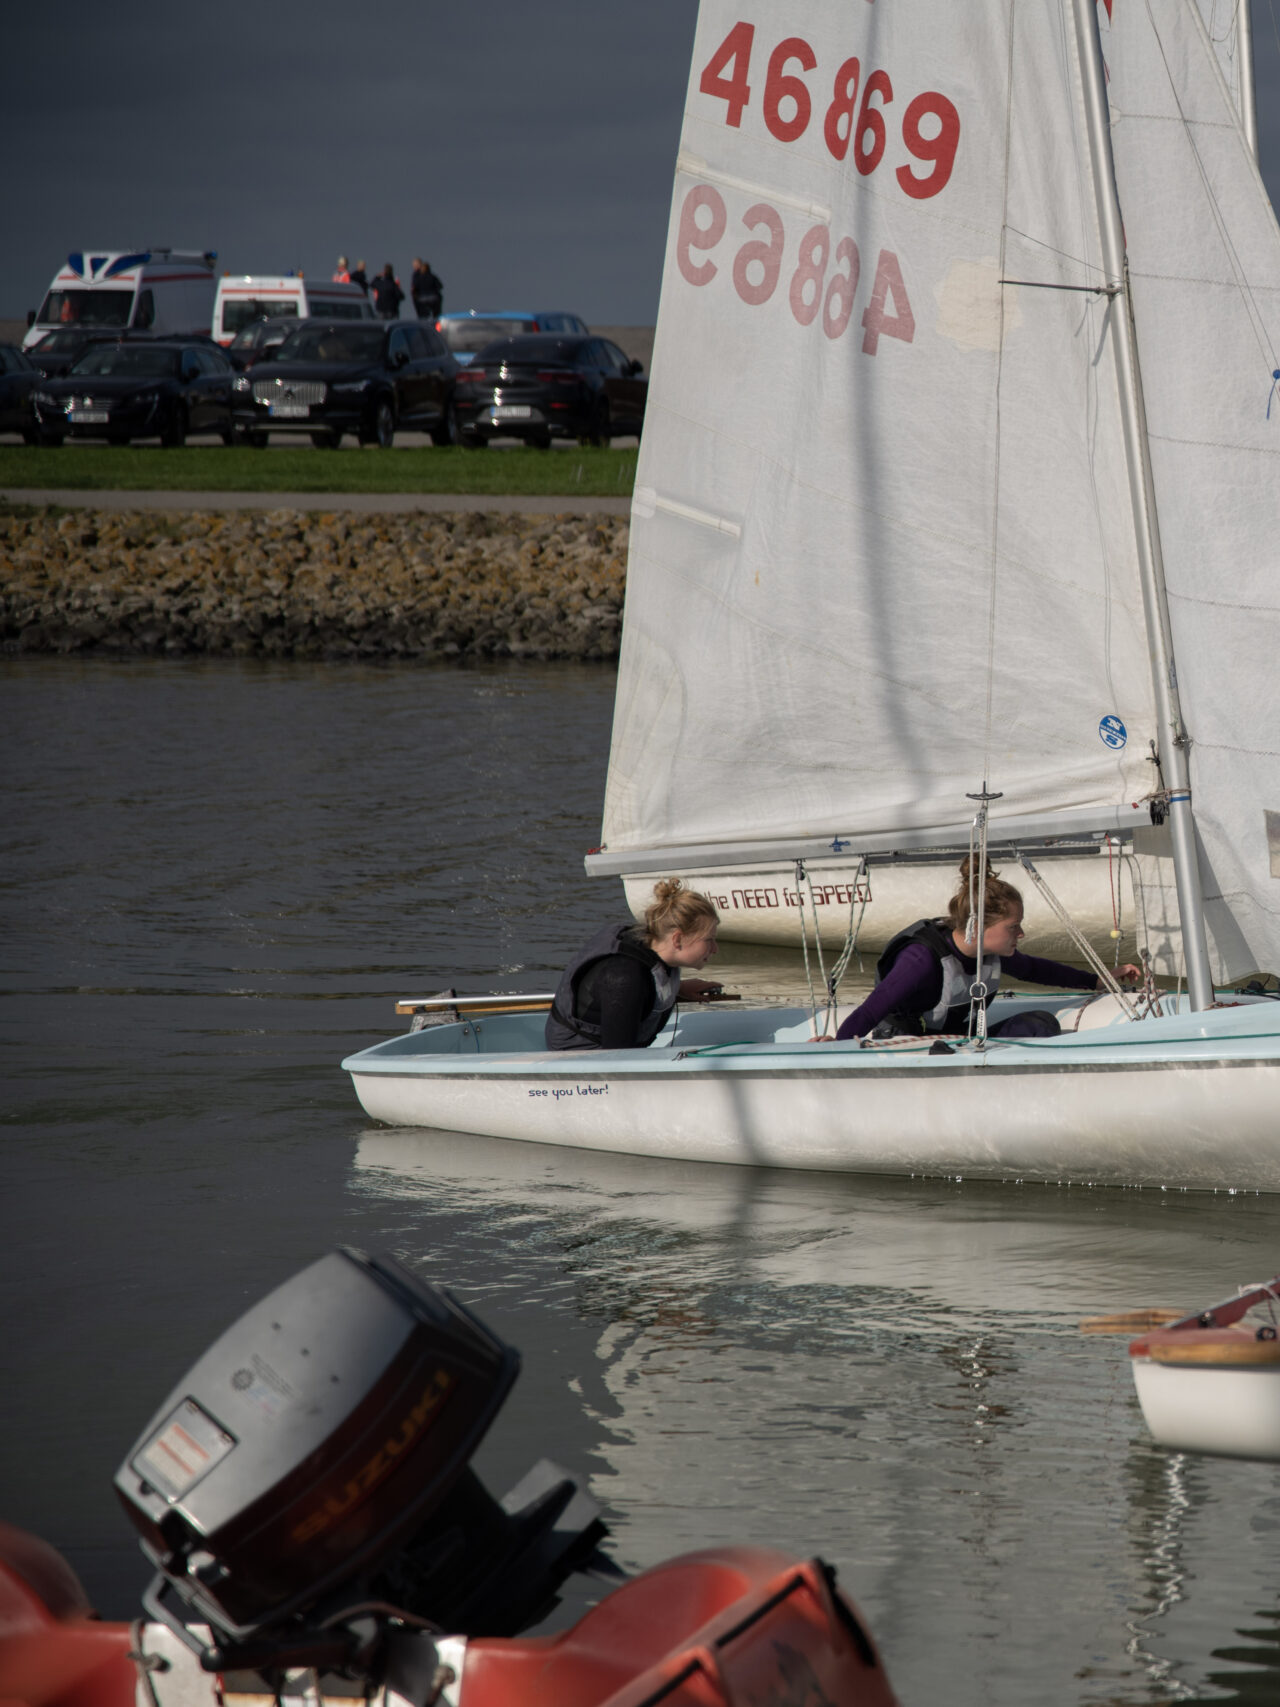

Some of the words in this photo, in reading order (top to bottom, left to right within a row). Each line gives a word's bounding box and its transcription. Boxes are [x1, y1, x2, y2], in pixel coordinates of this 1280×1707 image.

[699, 21, 961, 199] 46869
[731, 888, 780, 910] NEED
[783, 887, 805, 907] for
[811, 883, 873, 906] SPEED
[528, 1089, 549, 1097] see
[552, 1088, 573, 1101] you
[576, 1083, 609, 1096] later!
[291, 1368, 454, 1544] SUZUKI
